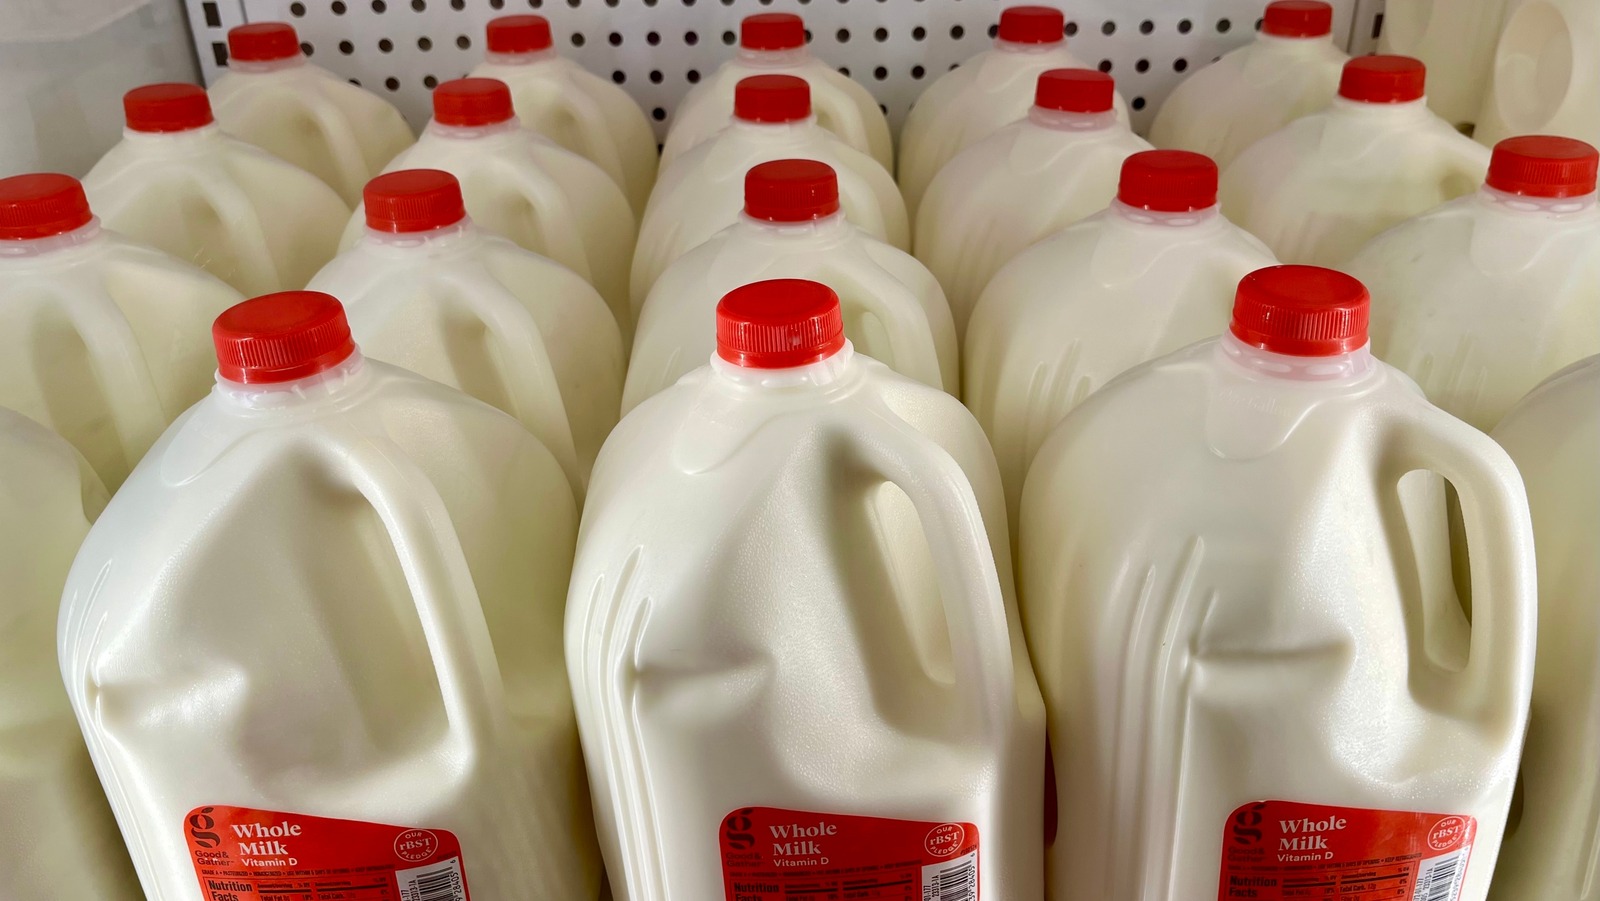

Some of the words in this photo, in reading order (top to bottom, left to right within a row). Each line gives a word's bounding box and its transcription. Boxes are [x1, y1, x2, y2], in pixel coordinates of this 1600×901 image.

[230, 821, 302, 838] Whole
[769, 821, 838, 839] Whole
[936, 826, 953, 834] OUR
[1279, 815, 1347, 834] Whole
[1441, 819, 1457, 827] OUR
[930, 831, 959, 846] rBST
[1433, 825, 1462, 840] rBST
[238, 840, 289, 856] Milk
[399, 837, 432, 851] rBST
[773, 841, 821, 856] Milk
[931, 840, 958, 854] PLEDGE
[1278, 835, 1328, 851] Milk
[401, 847, 432, 859] PLEDGE
[1277, 852, 1321, 862] Vitamin
[1324, 851, 1334, 860] D
[241, 857, 287, 867] Vitamin
[289, 857, 298, 866] D
[773, 857, 817, 867] Vitamin
[820, 857, 829, 865] D
[450, 872, 462, 894] 28405
[968, 865, 976, 888] 28405
[1230, 875, 1277, 887] Nutrition
[208, 880, 253, 892] Nutrition
[734, 882, 779, 893] Nutrition
[1229, 887, 1257, 898] Facts
[211, 891, 239, 901] Facts
